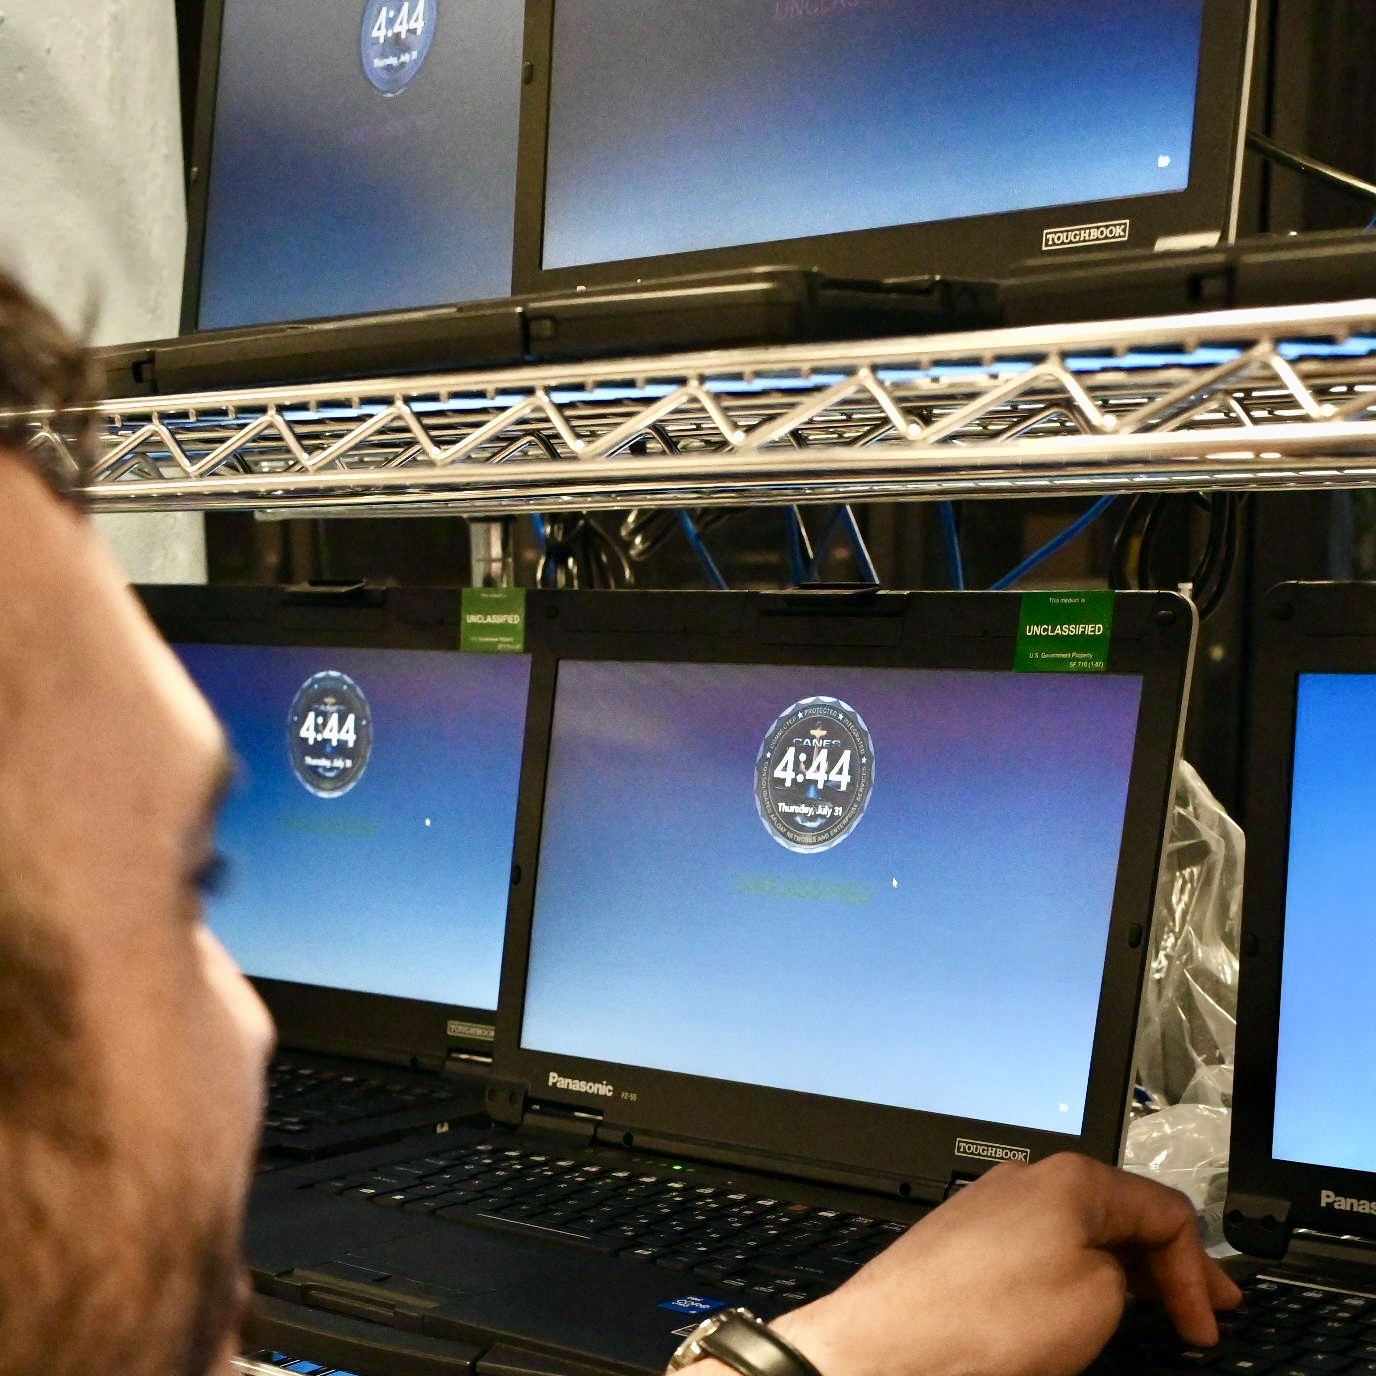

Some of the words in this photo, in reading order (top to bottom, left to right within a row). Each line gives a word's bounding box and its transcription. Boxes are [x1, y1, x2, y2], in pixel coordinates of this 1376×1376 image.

[371, 0, 425, 43] 4:44
[1046, 224, 1125, 245] TOUGHBOOK
[466, 614, 520, 624] UNCLASSIFIED
[1026, 624, 1104, 636] UNCLASSIFIED
[299, 711, 357, 748] 4:44
[773, 747, 851, 791] 4:44
[777, 802, 815, 817] Thursday,
[816, 804, 833, 819] July
[834, 806, 843, 816] 31
[548, 1071, 614, 1097] Panasonic
[958, 1142, 1027, 1162] TOUGHBOOK
